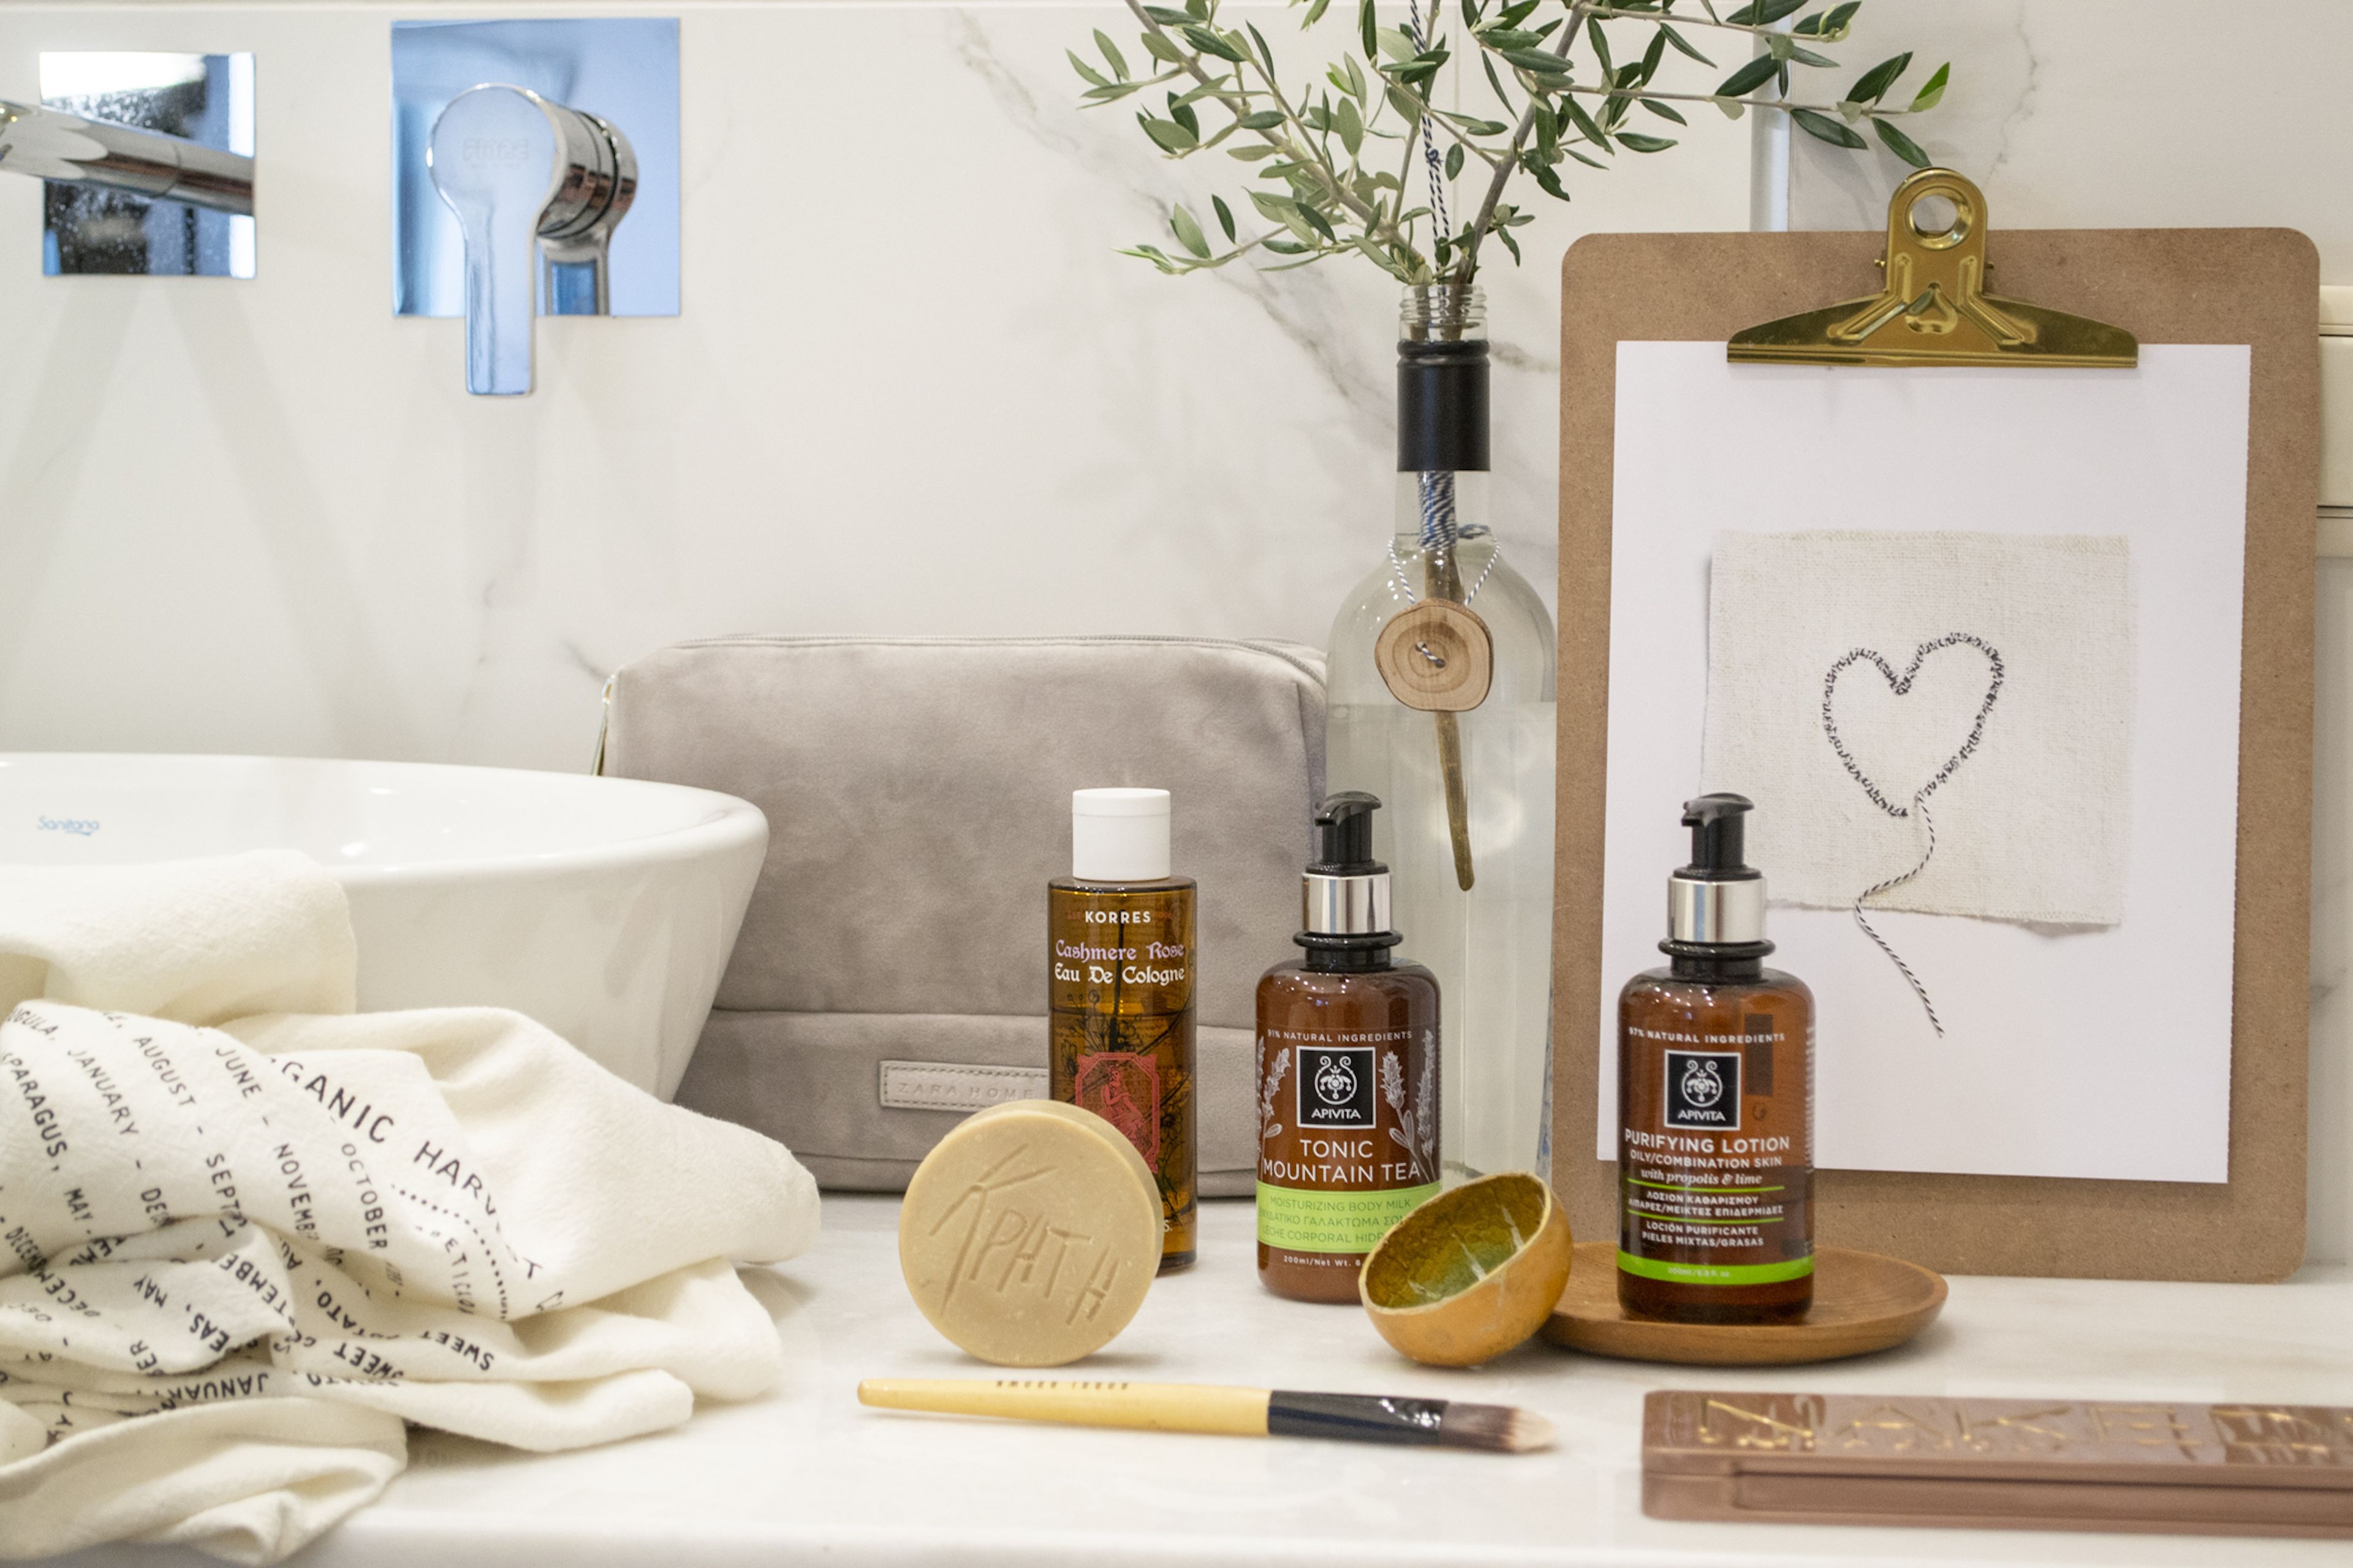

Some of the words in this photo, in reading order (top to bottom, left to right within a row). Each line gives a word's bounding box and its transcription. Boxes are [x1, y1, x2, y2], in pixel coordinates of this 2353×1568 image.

[1085, 910, 1152, 924] KORRES
[1056, 939, 1137, 963] Cashmere
[1146, 941, 1184, 960] Rose
[1055, 961, 1080, 982] Eau
[1088, 964, 1114, 984] De
[1121, 965, 1185, 987] Cologne
[1284, 1031, 1332, 1042] NATURAL
[1338, 1031, 1412, 1042] INGREDIENTS
[1647, 1030, 1700, 1043] NATURAL
[1705, 1033, 1786, 1043] INGREDIENTS
[134, 1036, 197, 1108] AUGUST
[216, 1047, 262, 1099] JUNE
[68, 1049, 138, 1136] JANUARY
[898, 1082, 958, 1097] ZARA
[969, 1086, 1035, 1101] HOME
[1311, 1108, 1362, 1119] APIVITA
[1677, 1109, 1727, 1121] APIVITA
[1299, 1139, 1374, 1158] TONIC
[1625, 1128, 1715, 1153] PURIFYING
[1722, 1135, 1790, 1154] LOTION
[1630, 1148, 1750, 1169] OILY/COMBINATION
[1754, 1156, 1783, 1168] SKIN
[1263, 1157, 1374, 1183] MOUNTAIN
[1381, 1161, 1422, 1182] TEA
[1640, 1168, 1664, 1181] with
[1666, 1172, 1719, 1186] propolis
[1721, 1173, 1733, 1185] &
[1735, 1173, 1762, 1184] lime
[341, 1142, 388, 1250] OCTOBER
[1270, 1195, 1345, 1211] MOISTURIZING
[1349, 1200, 1383, 1212] BODY
[1386, 1199, 1412, 1210] MILK
[1287, 1229, 1353, 1243] CORPORAL
[1642, 1231, 1673, 1243] PIELES
[1675, 1237, 1765, 1248] MIXTAS/GRASAS
[1686, 1225, 1759, 1235] PURIFICANTE
[133, 1274, 169, 1308] MAY
